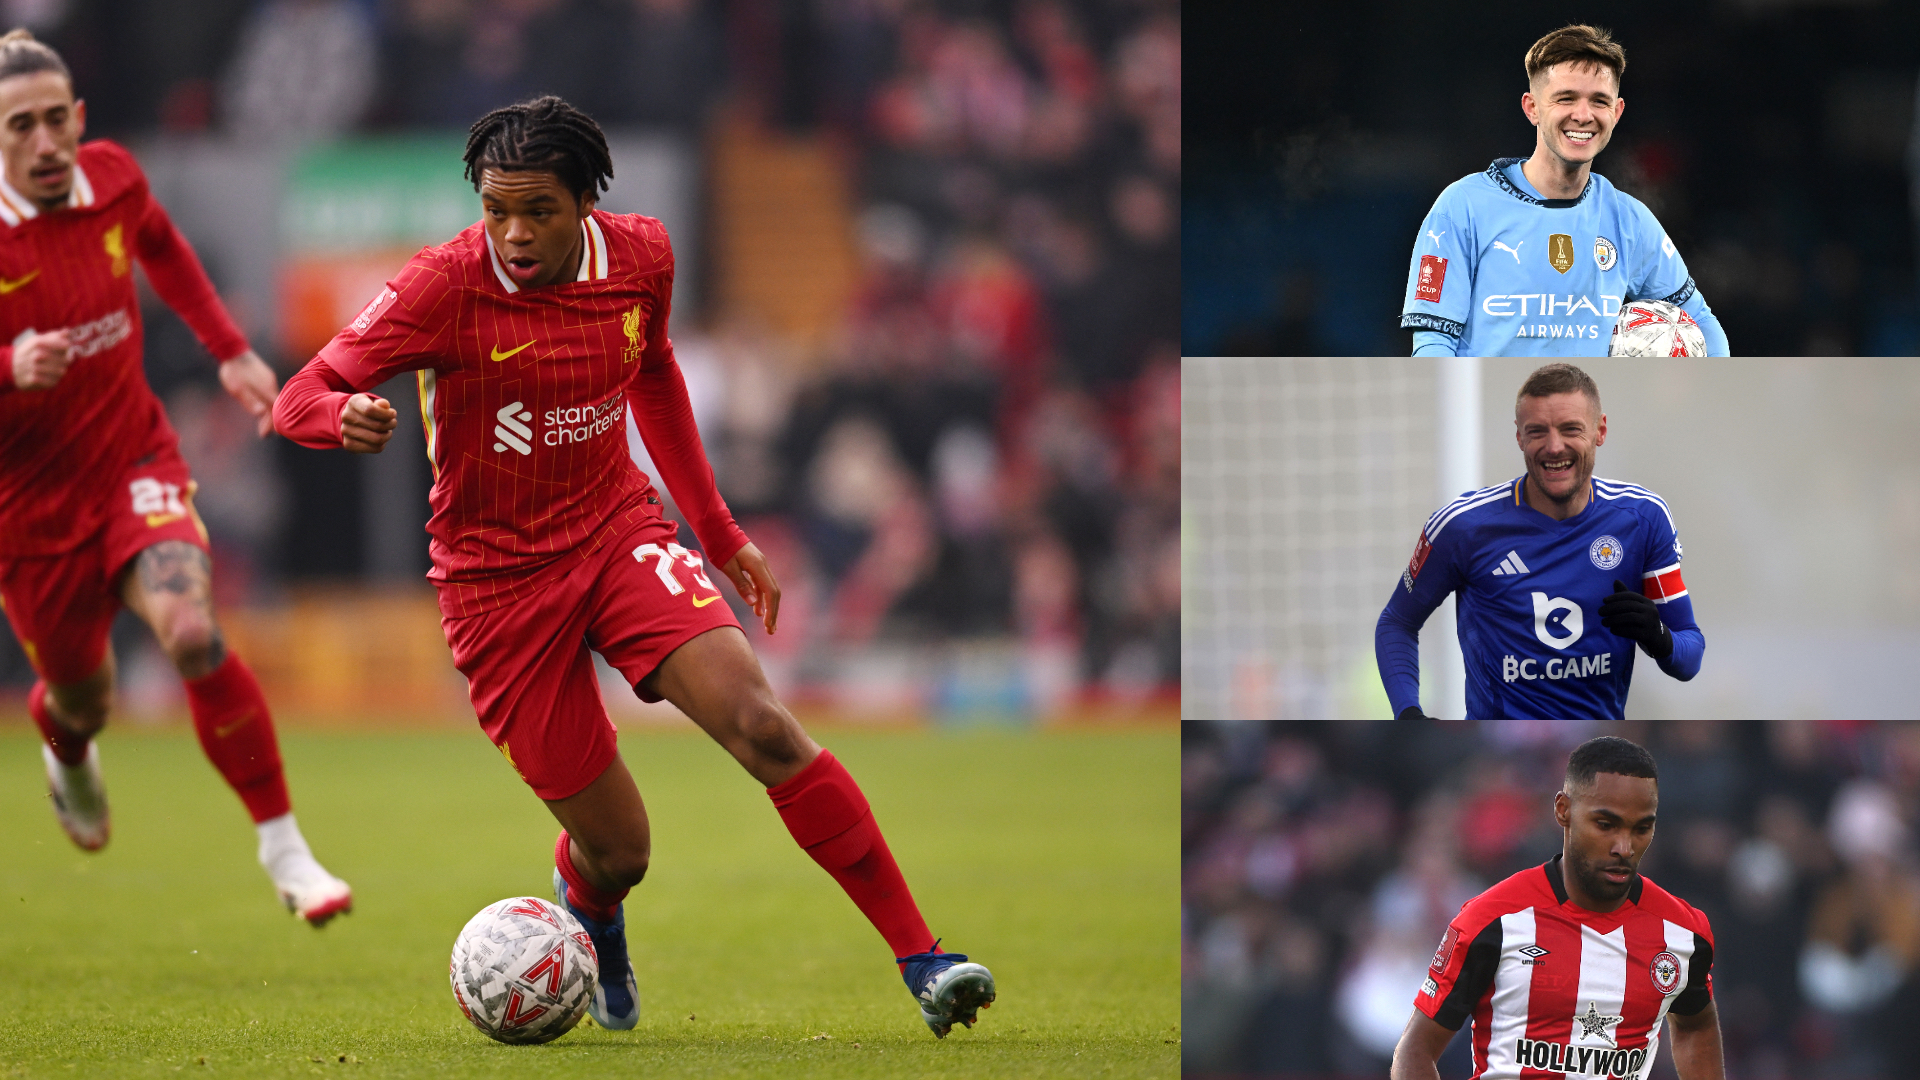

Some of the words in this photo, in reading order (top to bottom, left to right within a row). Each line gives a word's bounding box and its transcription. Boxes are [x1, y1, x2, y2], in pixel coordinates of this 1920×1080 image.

[1482, 293, 1624, 317] ETIHAD
[1516, 324, 1599, 340] AIRWAYS
[544, 391, 623, 426] stanar
[1521, 958, 1546, 966] umbro
[1515, 1038, 1648, 1078] HOLLYWOOD
